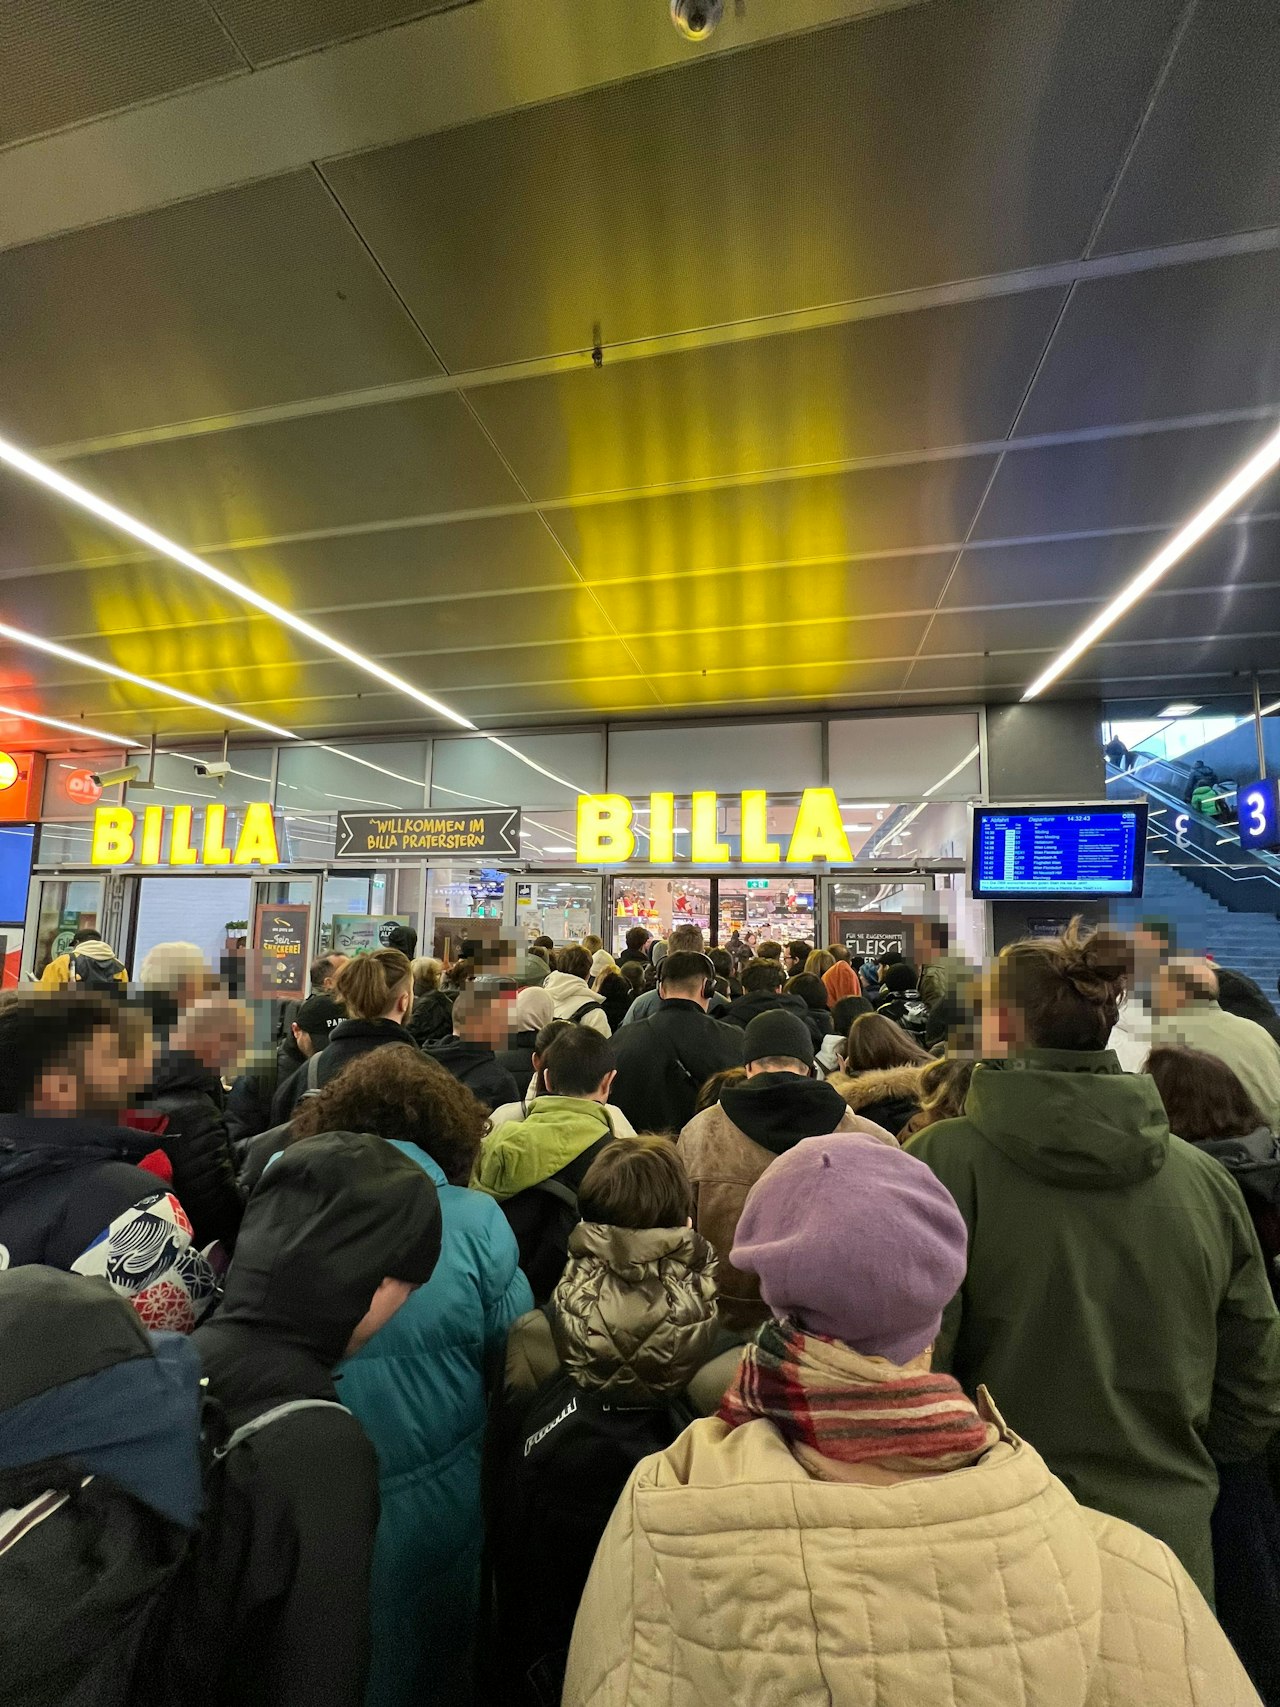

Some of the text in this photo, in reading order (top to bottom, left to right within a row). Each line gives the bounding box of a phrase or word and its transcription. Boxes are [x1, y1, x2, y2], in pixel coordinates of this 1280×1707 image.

[91, 803, 281, 865] BILLA
[375, 818, 485, 834] WILLKOMMEN IM
[577, 788, 854, 863] BILLA
[1247, 792, 1266, 836] 3
[367, 833, 485, 850] BILLA PRATERSTERN
